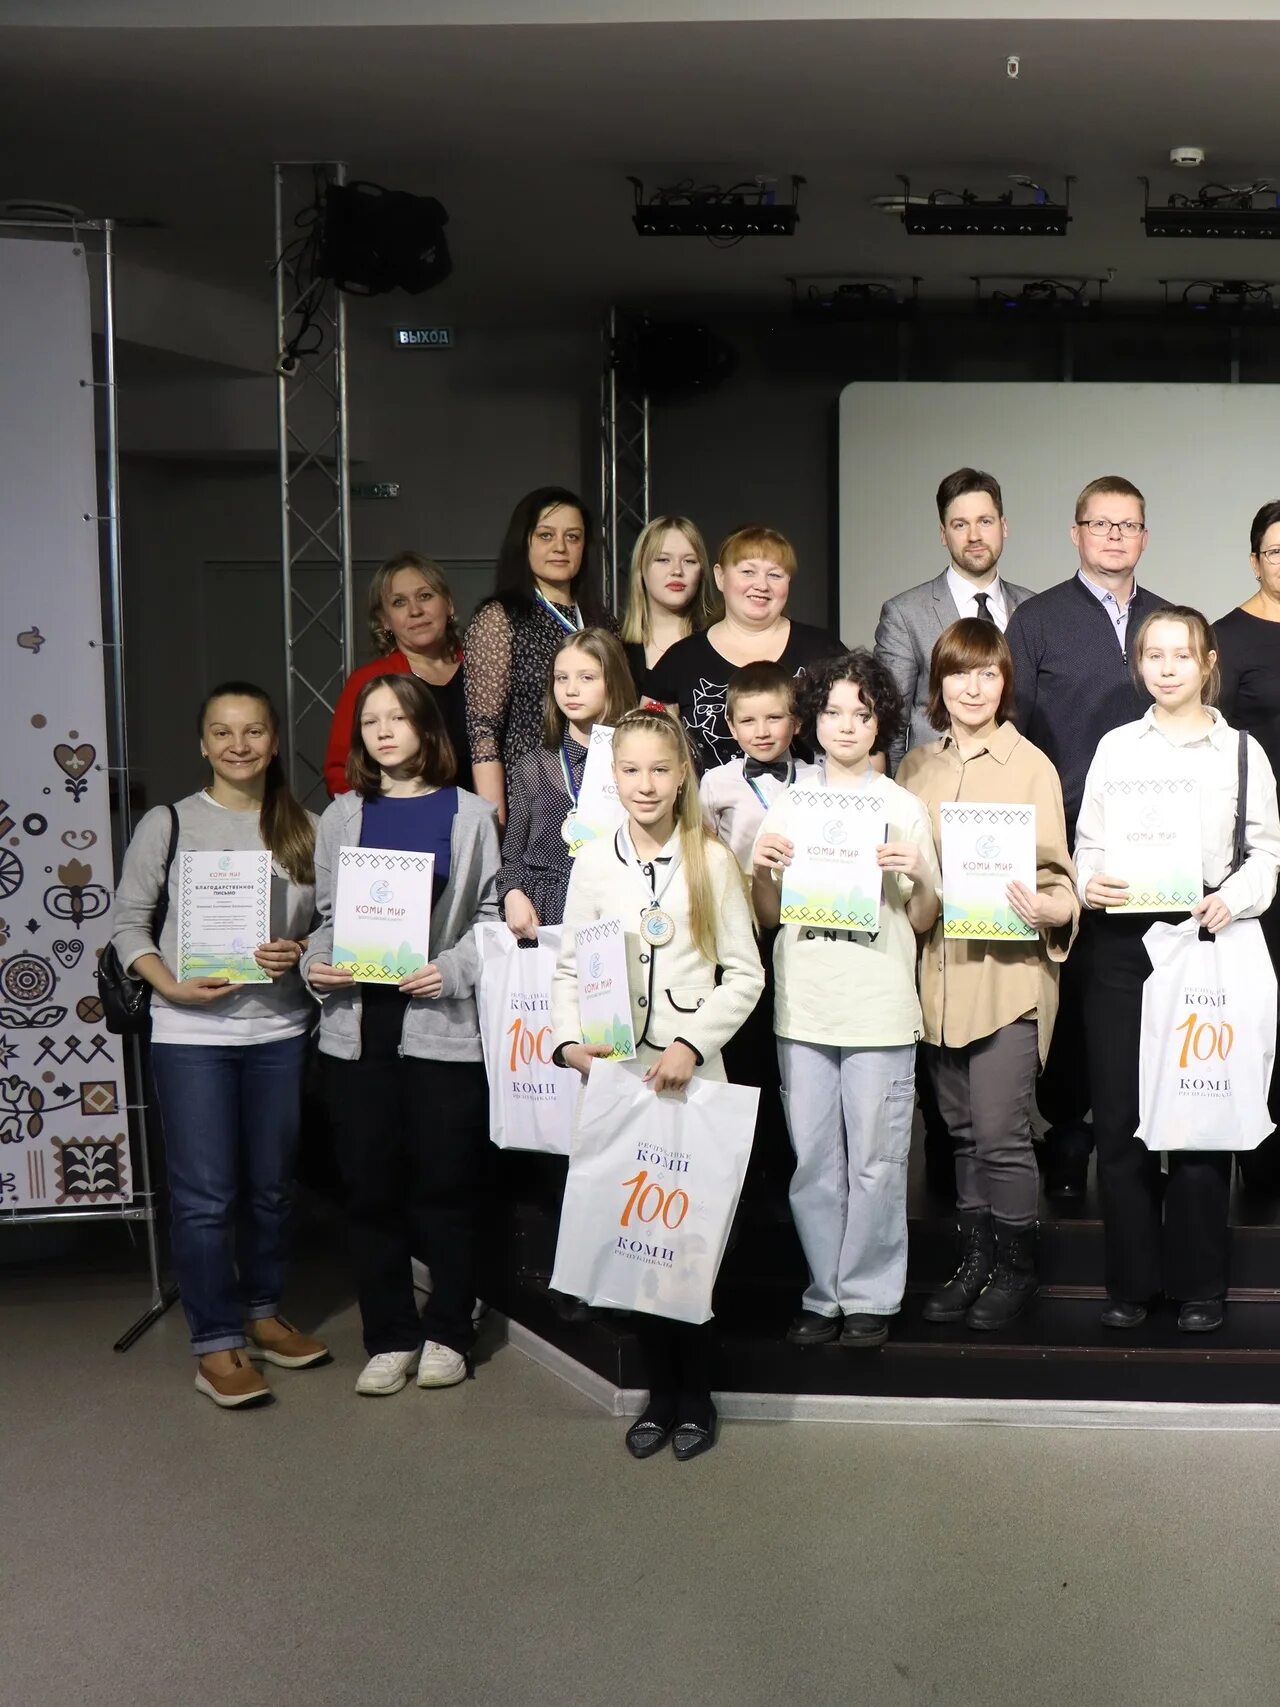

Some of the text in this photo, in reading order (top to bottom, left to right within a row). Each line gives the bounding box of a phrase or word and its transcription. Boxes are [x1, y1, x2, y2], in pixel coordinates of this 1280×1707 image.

[399, 330, 449, 344] ВЫХОД
[807, 846, 859, 858] КОМИ МИР
[962, 861, 1013, 872] КОМИ МИР
[355, 905, 406, 917] КОМИ МИР
[805, 929, 880, 943] ONLY
[583, 981, 599, 994] КОМИ
[600, 978, 612, 989] МИР
[506, 1017, 553, 1073] 100
[1175, 1012, 1234, 1068] 100
[512, 1081, 556, 1094] КОМИ
[636, 1149, 690, 1173] КОМИ
[620, 1170, 689, 1230] 100
[616, 1236, 675, 1262] КОМИ
